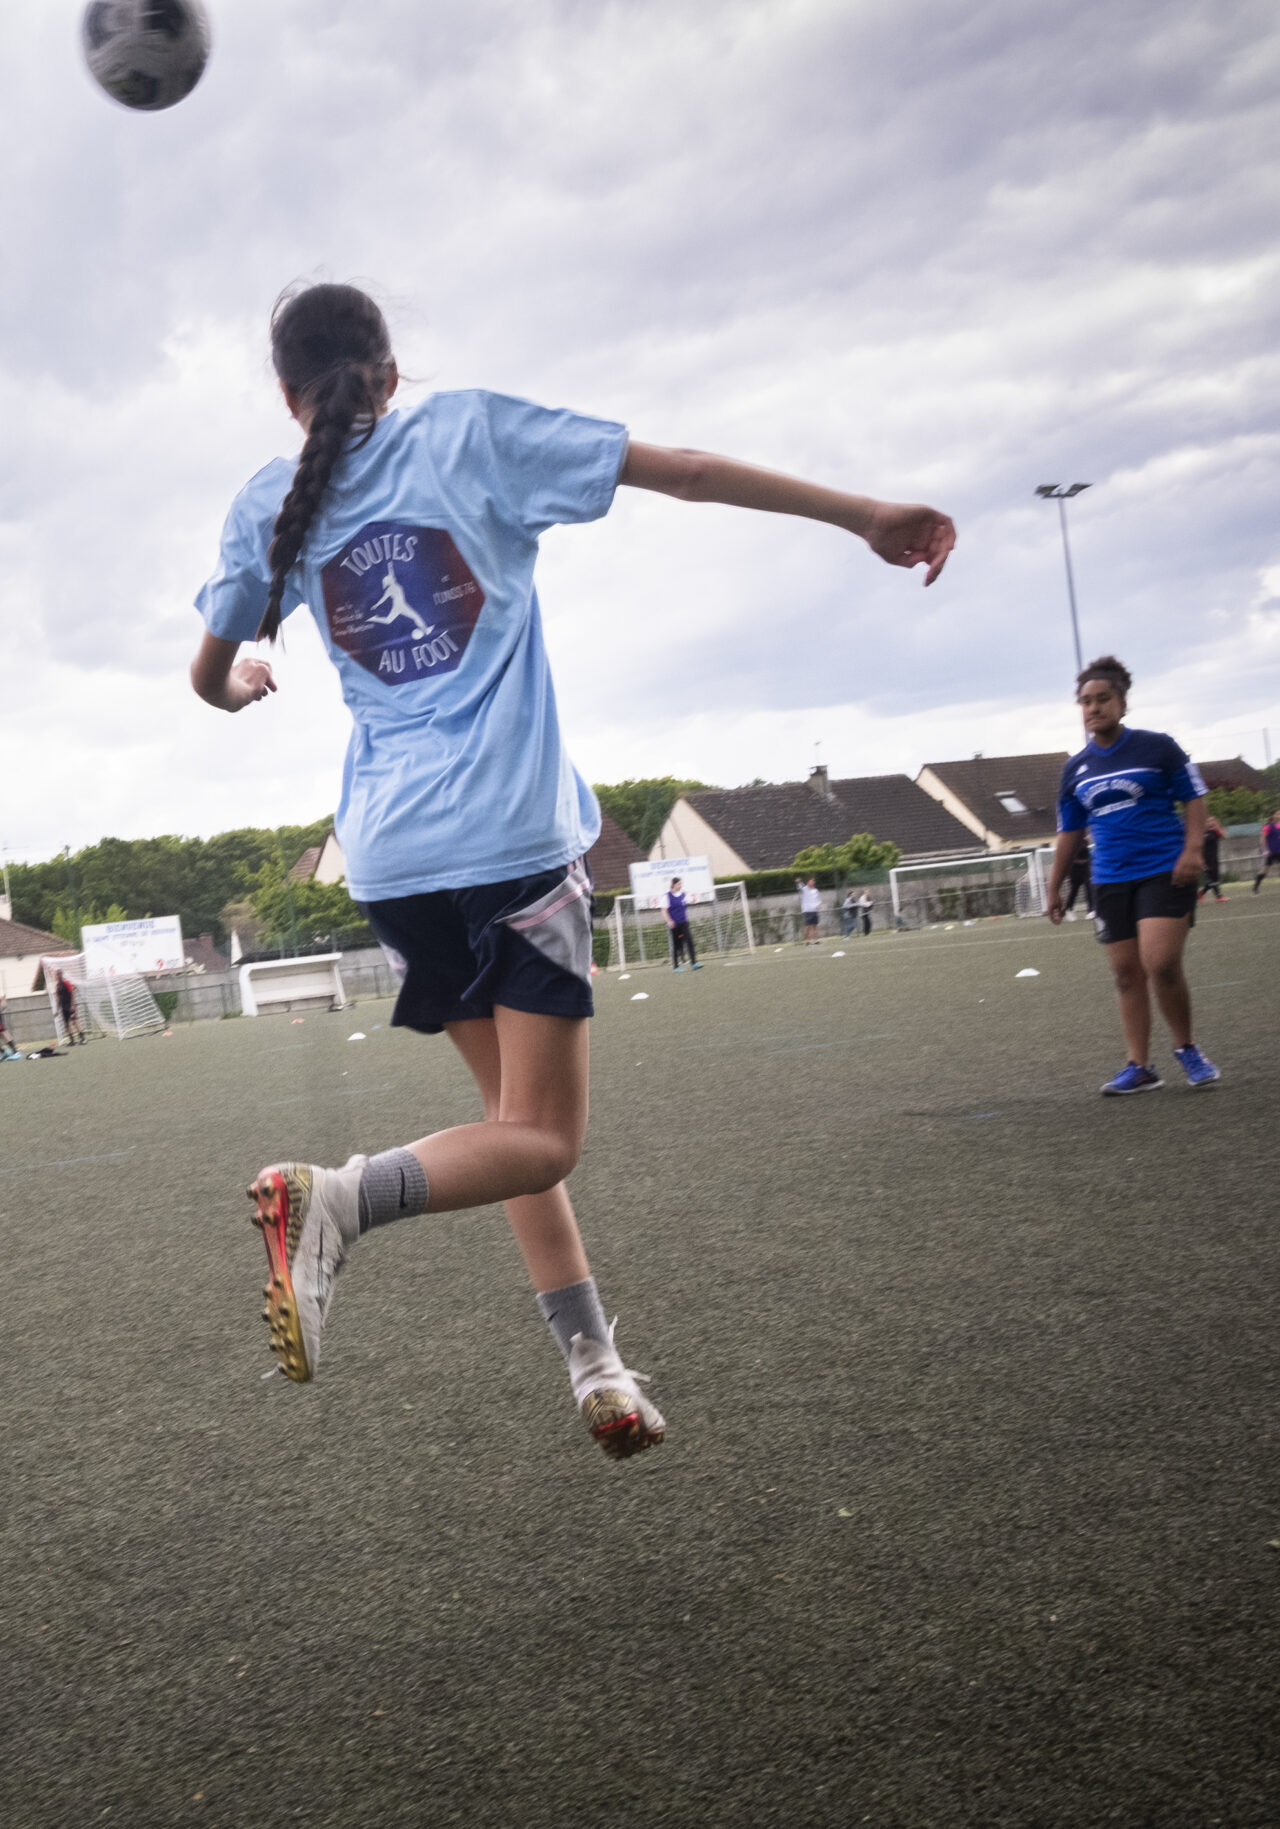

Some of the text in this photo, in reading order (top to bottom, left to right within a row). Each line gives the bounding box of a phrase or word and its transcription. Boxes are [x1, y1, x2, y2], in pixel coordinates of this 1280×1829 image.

[339, 532, 419, 577] TOUTES
[377, 648, 406, 675] AU
[411, 630, 460, 672] FOOT
